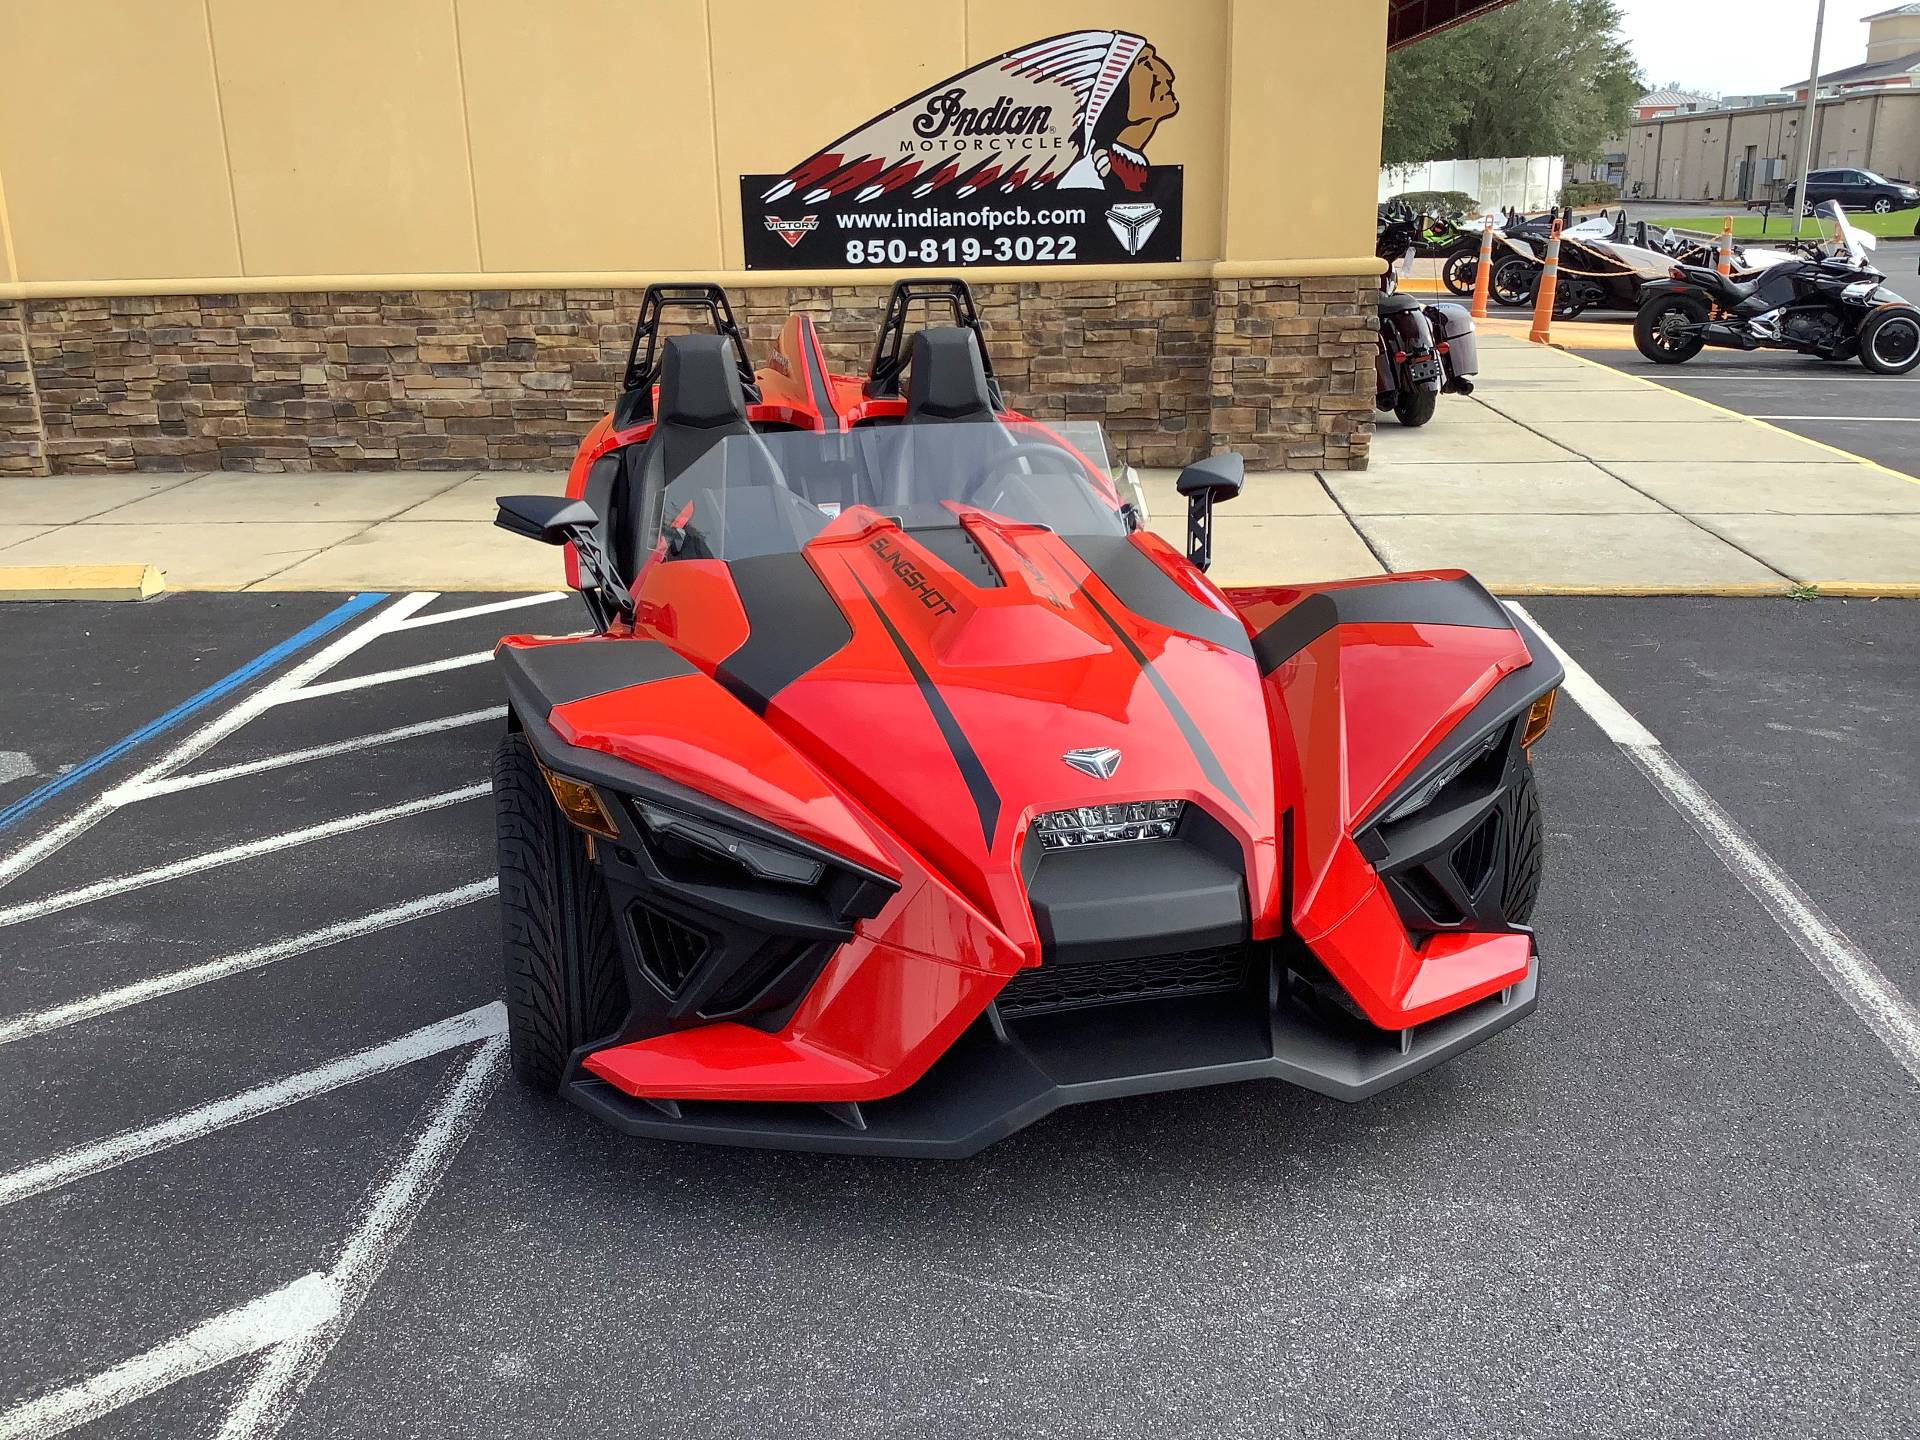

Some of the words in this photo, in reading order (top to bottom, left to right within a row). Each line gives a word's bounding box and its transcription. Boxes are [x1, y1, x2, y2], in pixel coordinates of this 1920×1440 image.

[913, 88, 1052, 138] Indian
[900, 137, 1062, 152] MOTORCYCLE
[836, 206, 1086, 230] www.indianofpcb.com
[846, 235, 1077, 264] 850-819-3022
[868, 537, 957, 616] SLINGSHOT
